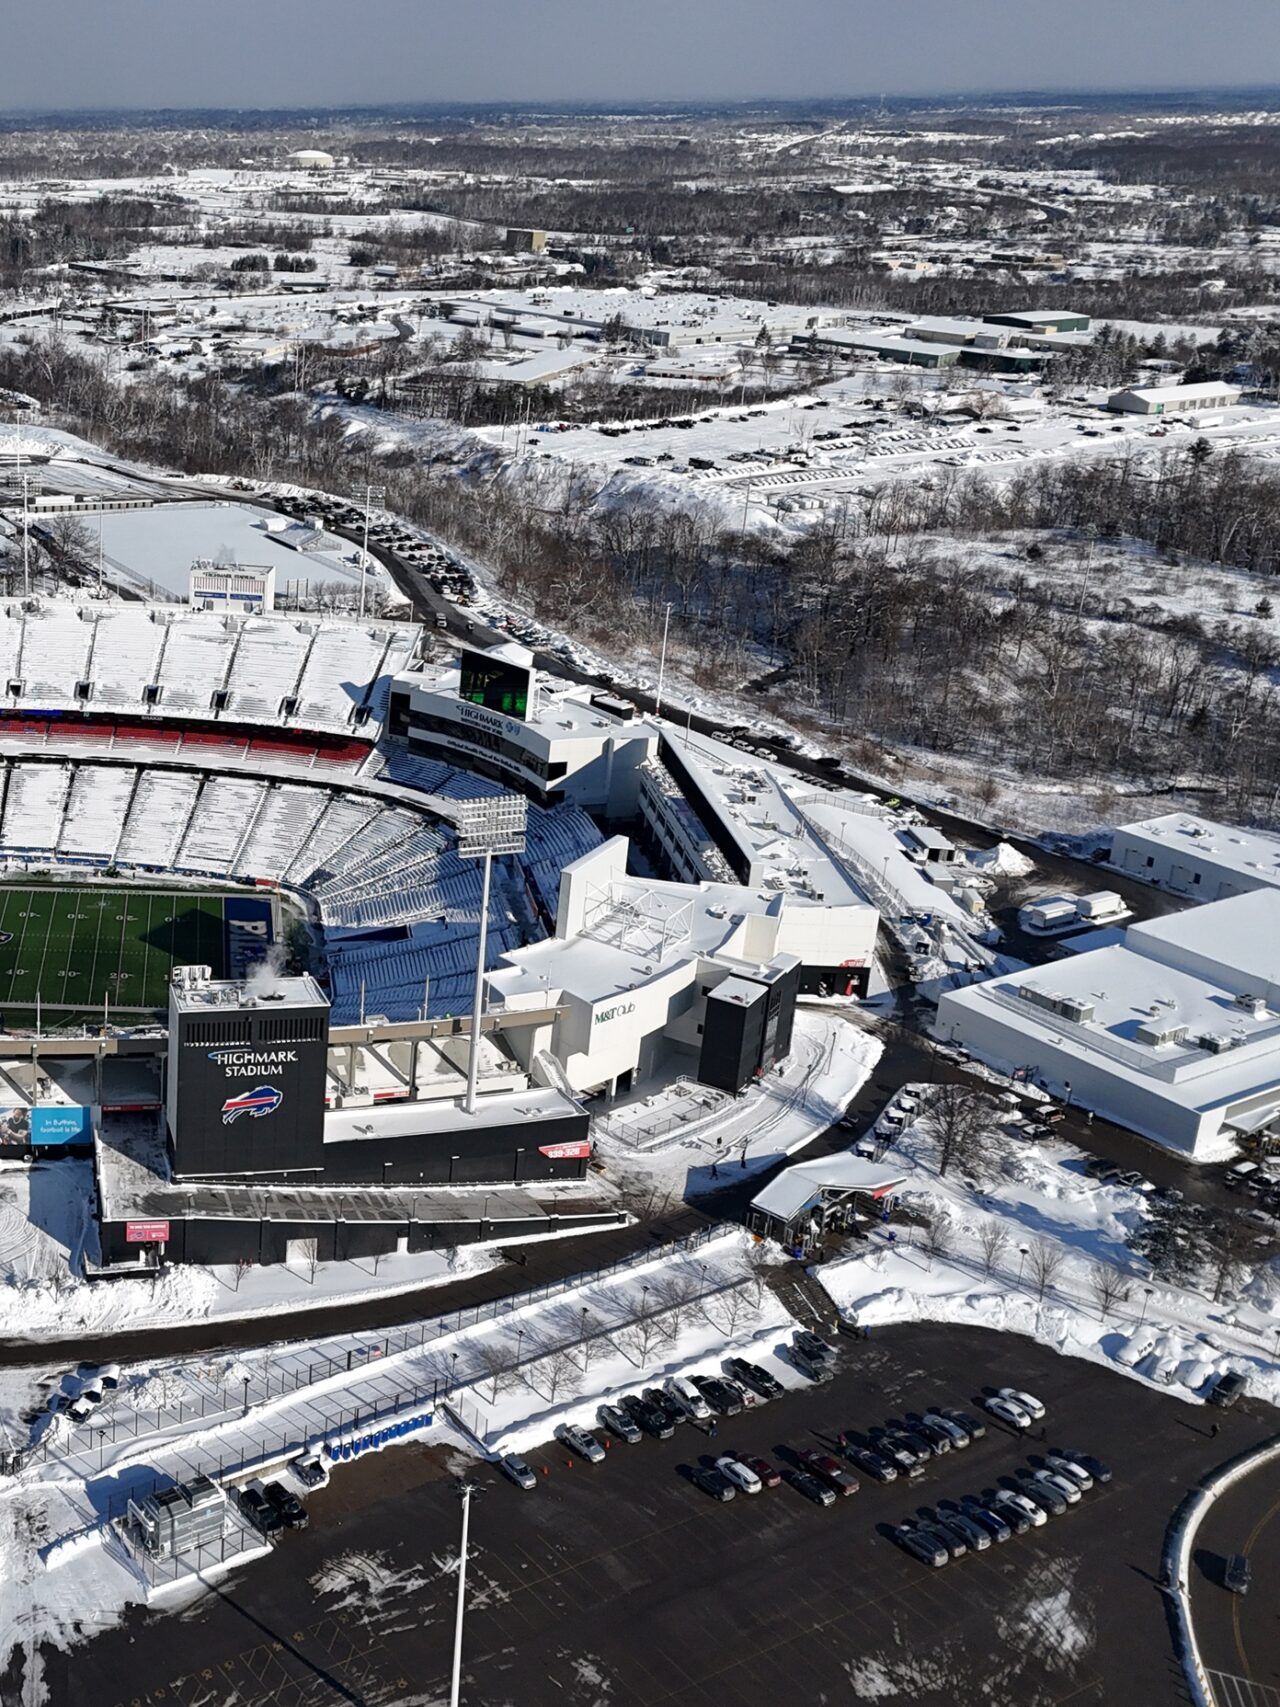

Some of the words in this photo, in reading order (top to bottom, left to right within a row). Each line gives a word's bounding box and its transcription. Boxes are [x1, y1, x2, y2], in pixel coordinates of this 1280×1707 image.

[460, 706, 504, 730] HIGHMARK
[216, 1050, 299, 1065] HIGHMARK
[224, 1064, 283, 1078] STADIUM
